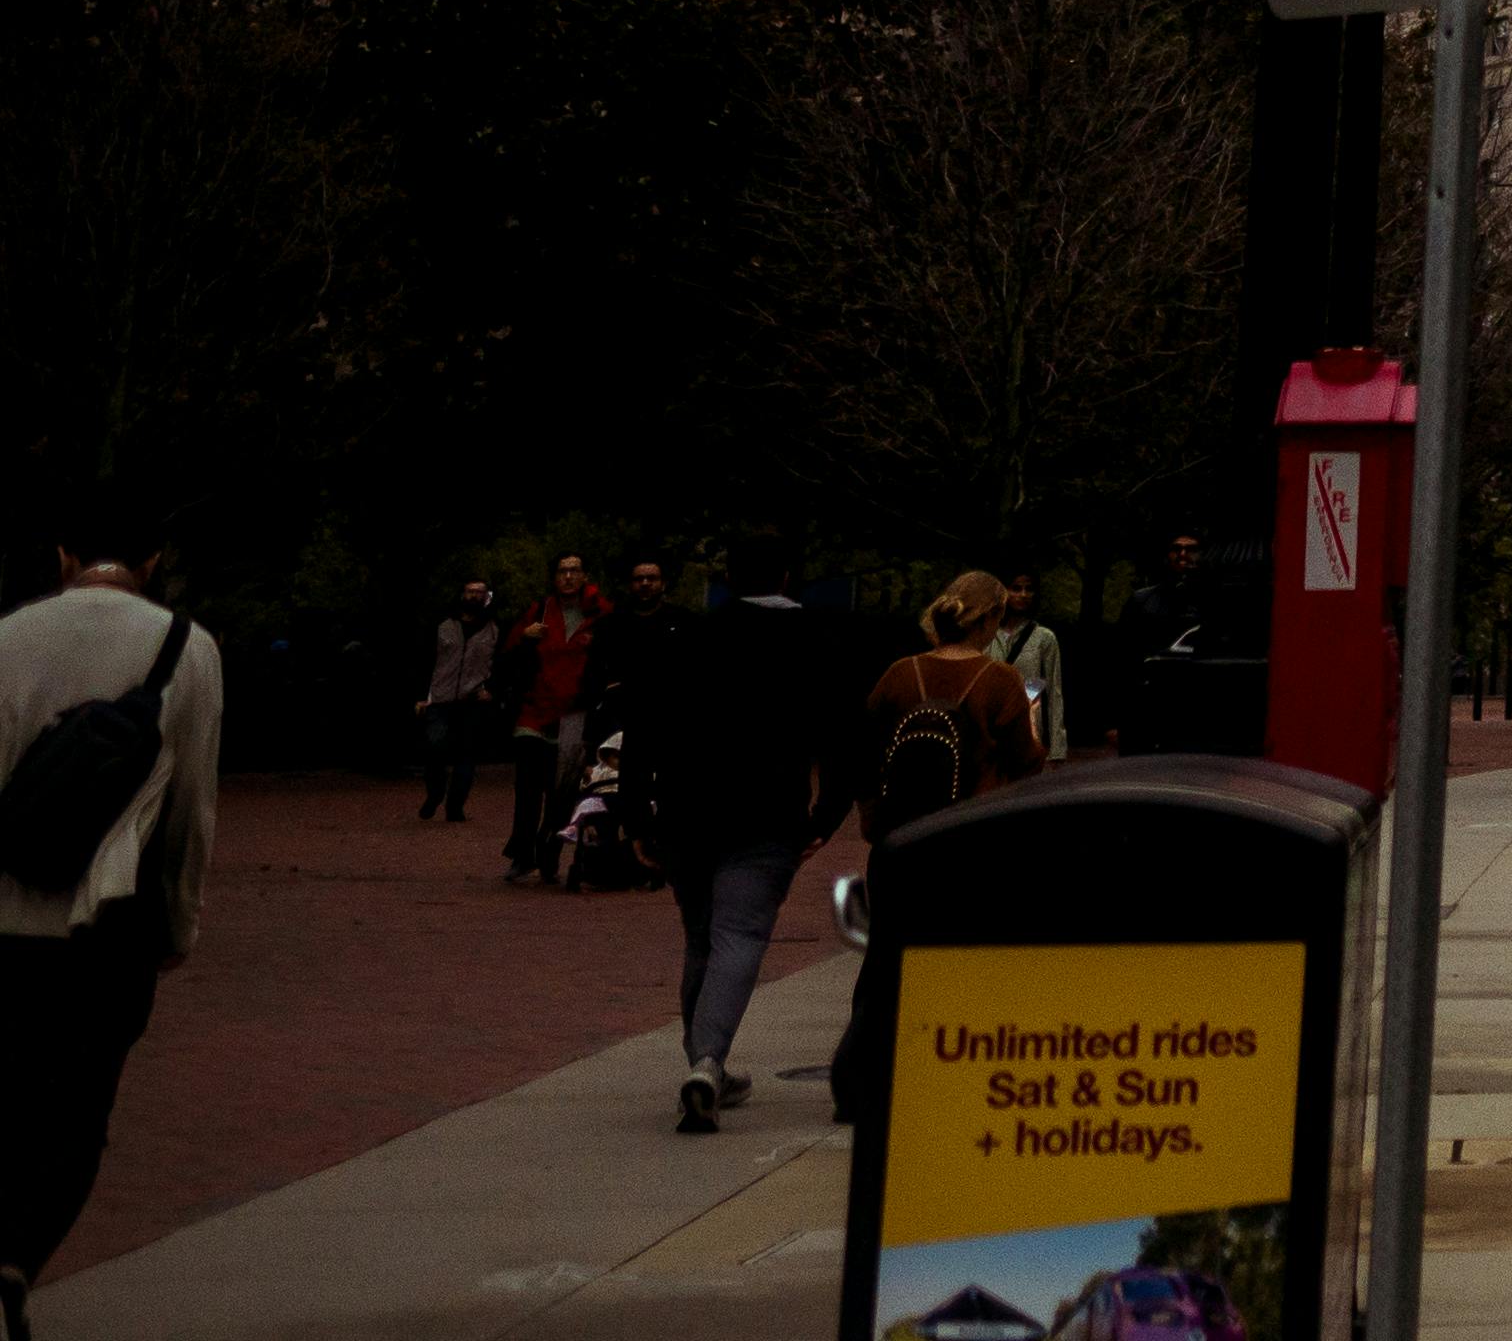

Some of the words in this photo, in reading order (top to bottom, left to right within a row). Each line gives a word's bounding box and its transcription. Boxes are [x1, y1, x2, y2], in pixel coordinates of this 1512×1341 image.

[1322, 458, 1351, 523] FIRE
[935, 1022, 1140, 1063] Unlimited
[1152, 1020, 1257, 1059] rides
[985, 1070, 1057, 1110] Sat
[1070, 1070, 1101, 1108] &
[1114, 1068, 1200, 1107] Sun
[975, 1129, 1000, 1158] +
[1014, 1117, 1204, 1163] holidays.
